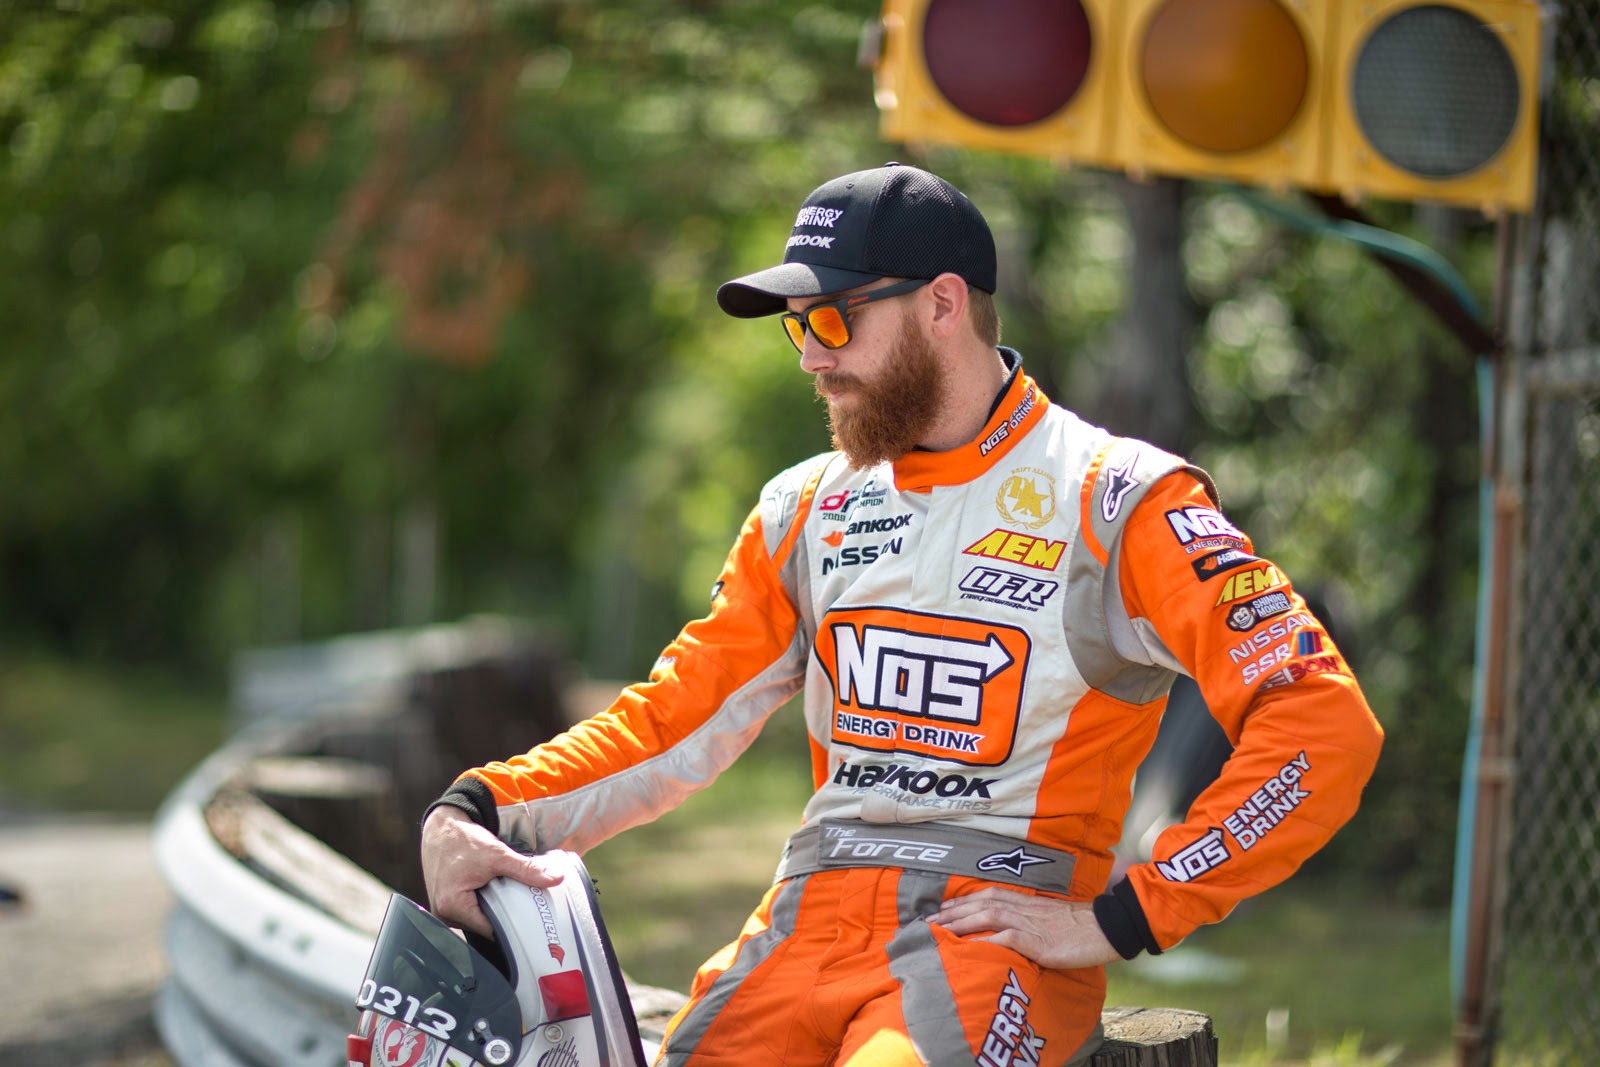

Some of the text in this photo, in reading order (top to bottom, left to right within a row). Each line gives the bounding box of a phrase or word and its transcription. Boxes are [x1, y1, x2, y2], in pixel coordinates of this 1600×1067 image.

[1010, 398, 1035, 429] DRINK
[979, 421, 1010, 457] NOS
[846, 513, 913, 536] ankook
[1164, 506, 1244, 546] NOS
[1185, 538, 1225, 554] ENERGY
[962, 528, 1068, 572] AEM
[1215, 565, 1283, 608] AEM
[1252, 593, 1287, 609] SHINING
[1256, 601, 1293, 618] MONKEY
[1228, 613, 1315, 665] NISSAN
[830, 622, 1014, 726] NOS
[1241, 642, 1293, 686] SSR
[836, 710, 985, 754] ENERGY DRINK
[945, 798, 992, 811] TIRES
[1222, 750, 1311, 835] ENERGY
[825, 826, 856, 839] The
[1234, 782, 1312, 851] DRINK
[829, 837, 954, 863] Force
[1154, 826, 1231, 883] NOS
[529, 886, 561, 945] Hankoo
[356, 979, 457, 1040] 0313
[977, 967, 1031, 1067] ERGY
